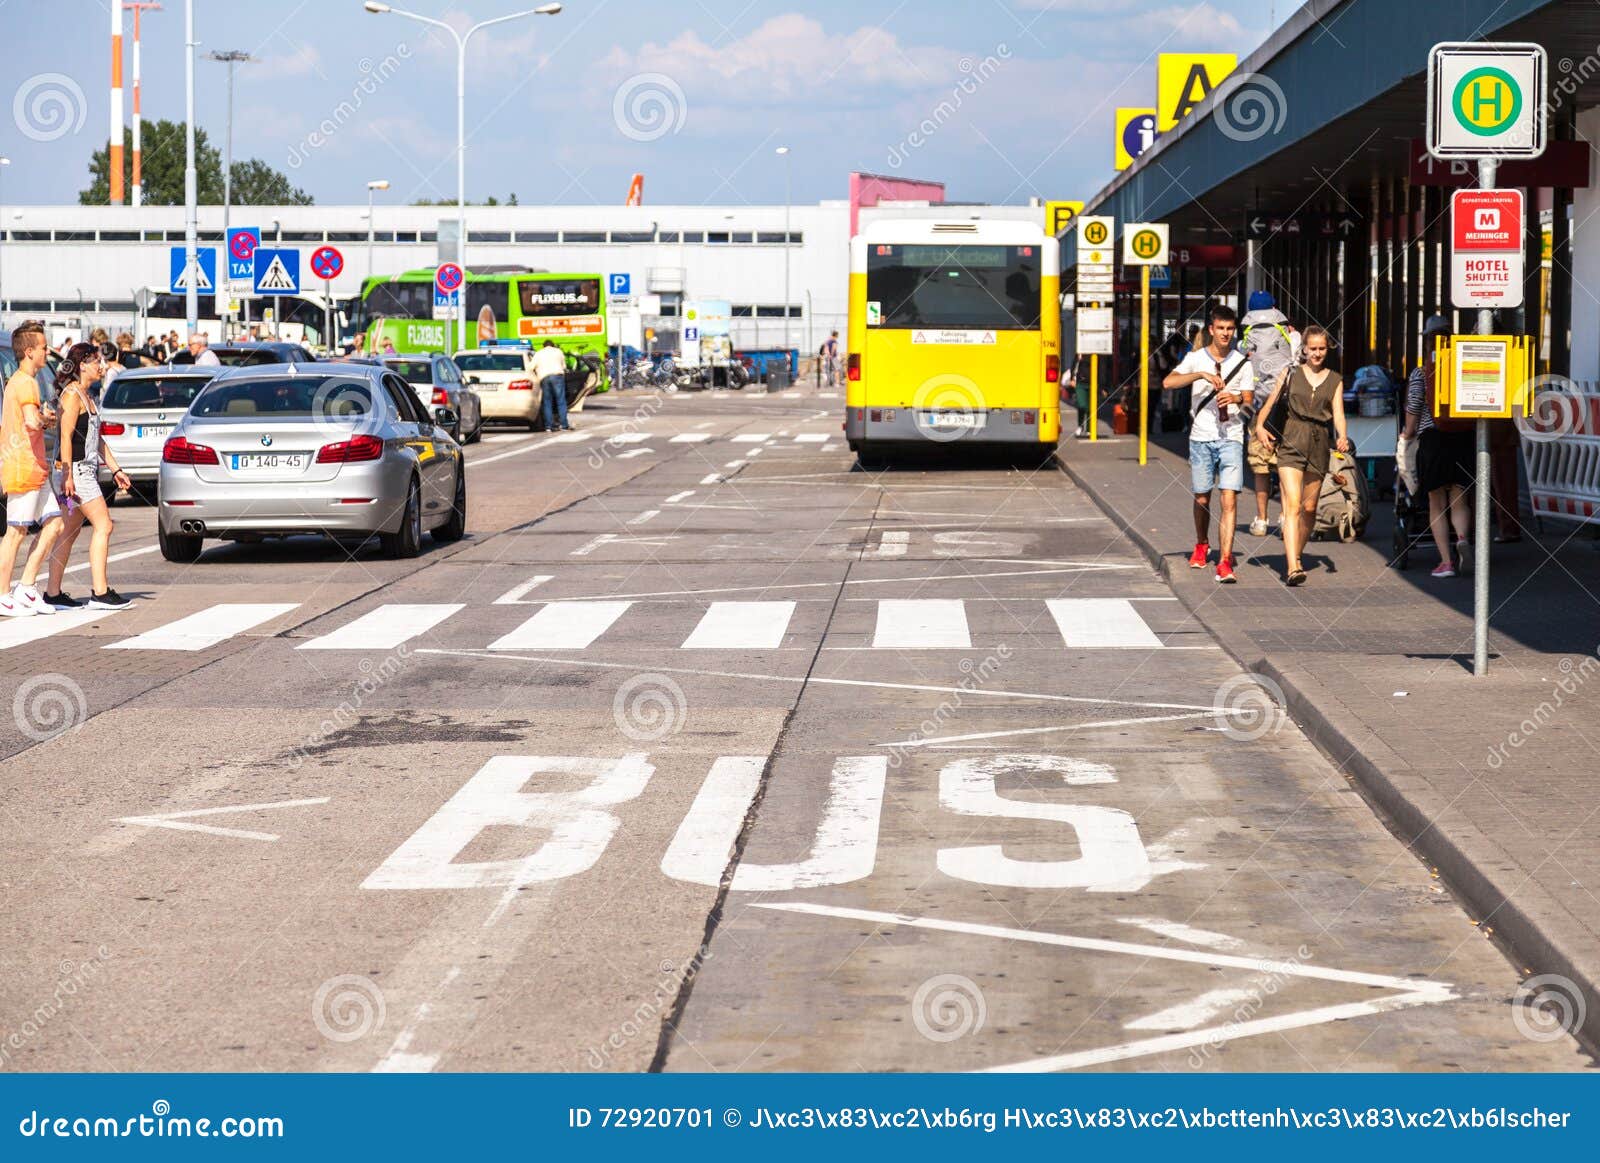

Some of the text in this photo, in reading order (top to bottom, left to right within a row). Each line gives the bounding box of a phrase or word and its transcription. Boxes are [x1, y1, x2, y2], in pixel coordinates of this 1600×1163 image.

[1172, 63, 1212, 120] A
[1473, 82, 1502, 121] H
[1479, 213, 1495, 225] M
[1090, 226, 1102, 240] H
[1465, 232, 1510, 240] MEININGER
[1139, 236, 1154, 252] H
[1180, 250, 1190, 262] B
[1465, 260, 1509, 272] HOTEL
[1465, 272, 1509, 281] SHUTTLE
[614, 275, 626, 292] P
[256, 455, 301, 468] 140-45
[361, 751, 1153, 893] BUS
